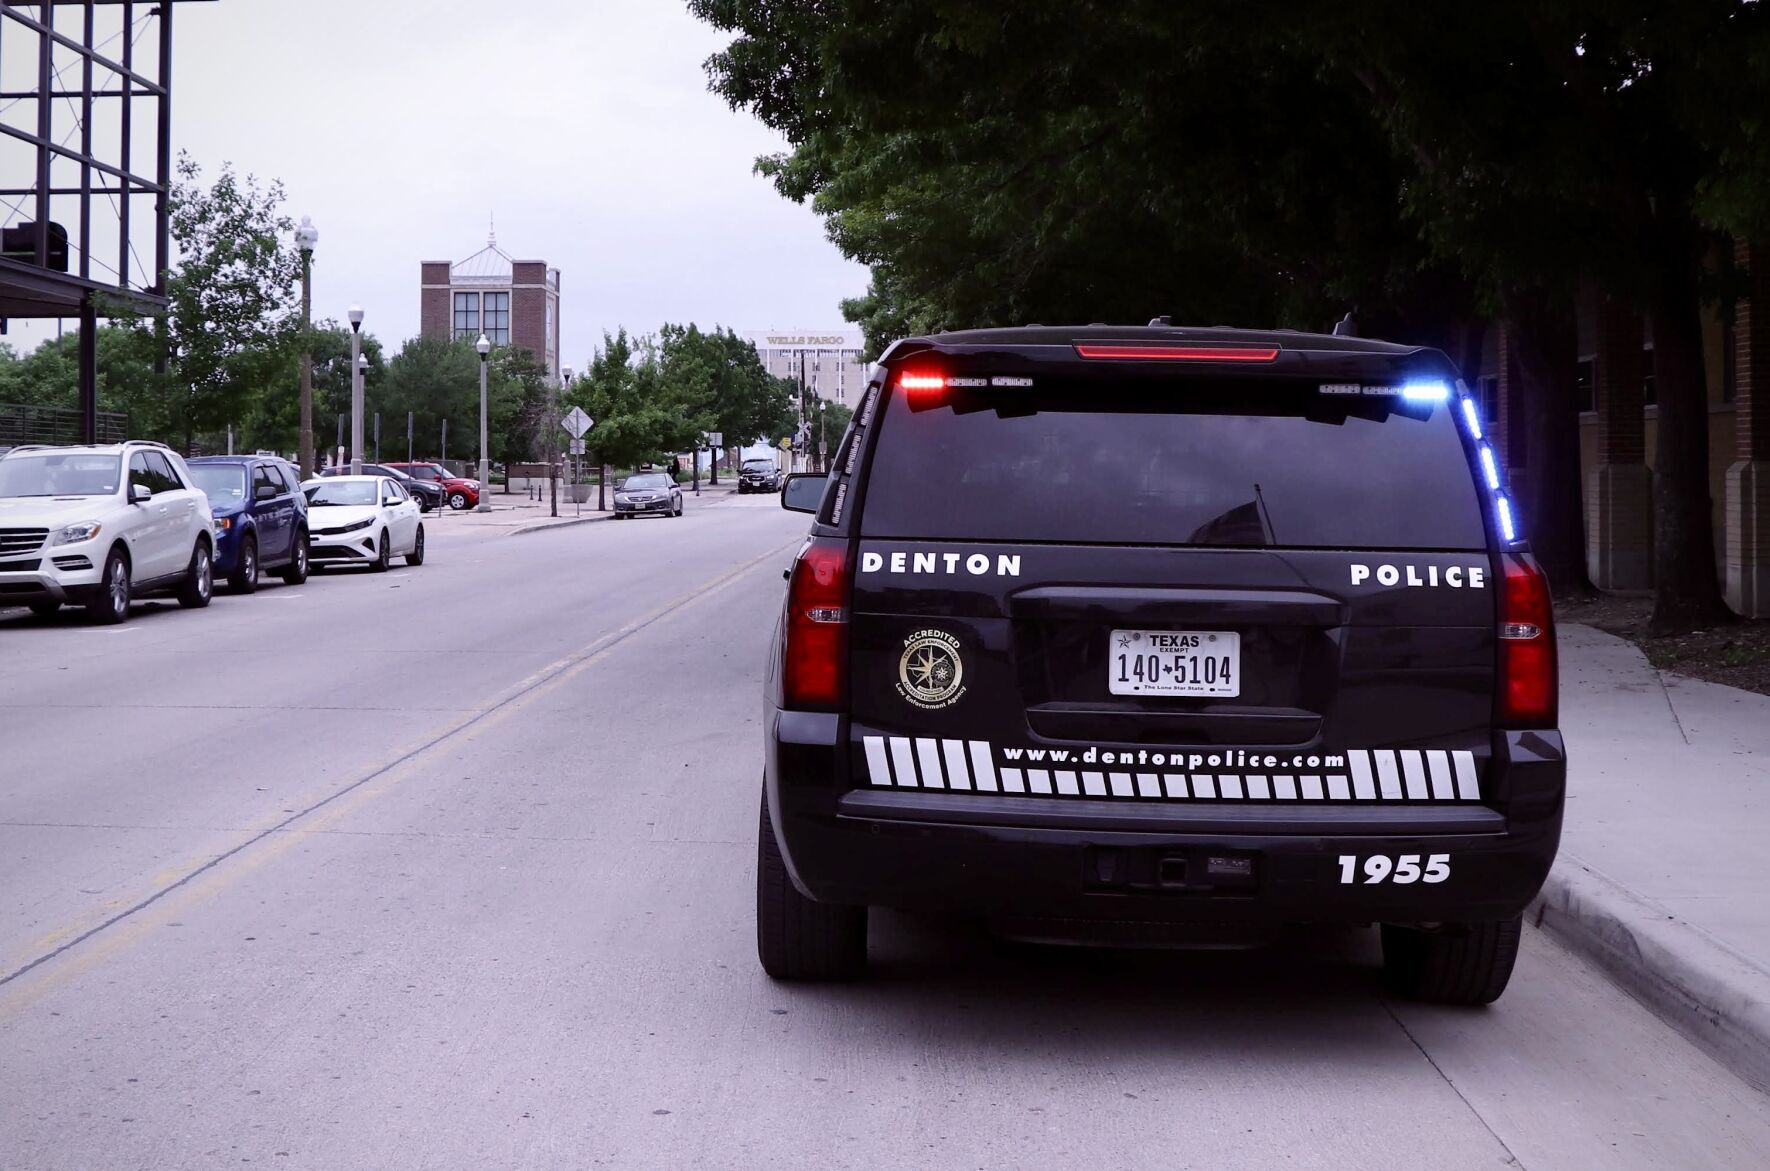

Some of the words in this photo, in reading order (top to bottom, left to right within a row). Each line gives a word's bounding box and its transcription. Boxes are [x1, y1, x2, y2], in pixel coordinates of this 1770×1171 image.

[766, 336, 805, 345] WELLS
[807, 336, 845, 345] FARGO
[862, 552, 1021, 576] DENTON
[1350, 564, 1485, 588] POLICE
[903, 629, 961, 649] ACCREDITED
[1150, 635, 1200, 647] TEXAS
[1118, 654, 1160, 683] 140
[1174, 655, 1231, 685] 5104
[895, 682, 906, 696] Law
[905, 694, 946, 709] Enforcement
[947, 686, 967, 706] Agency
[1003, 747, 1345, 770] www.dentonpolice.com
[1338, 853, 1451, 884] 1955
